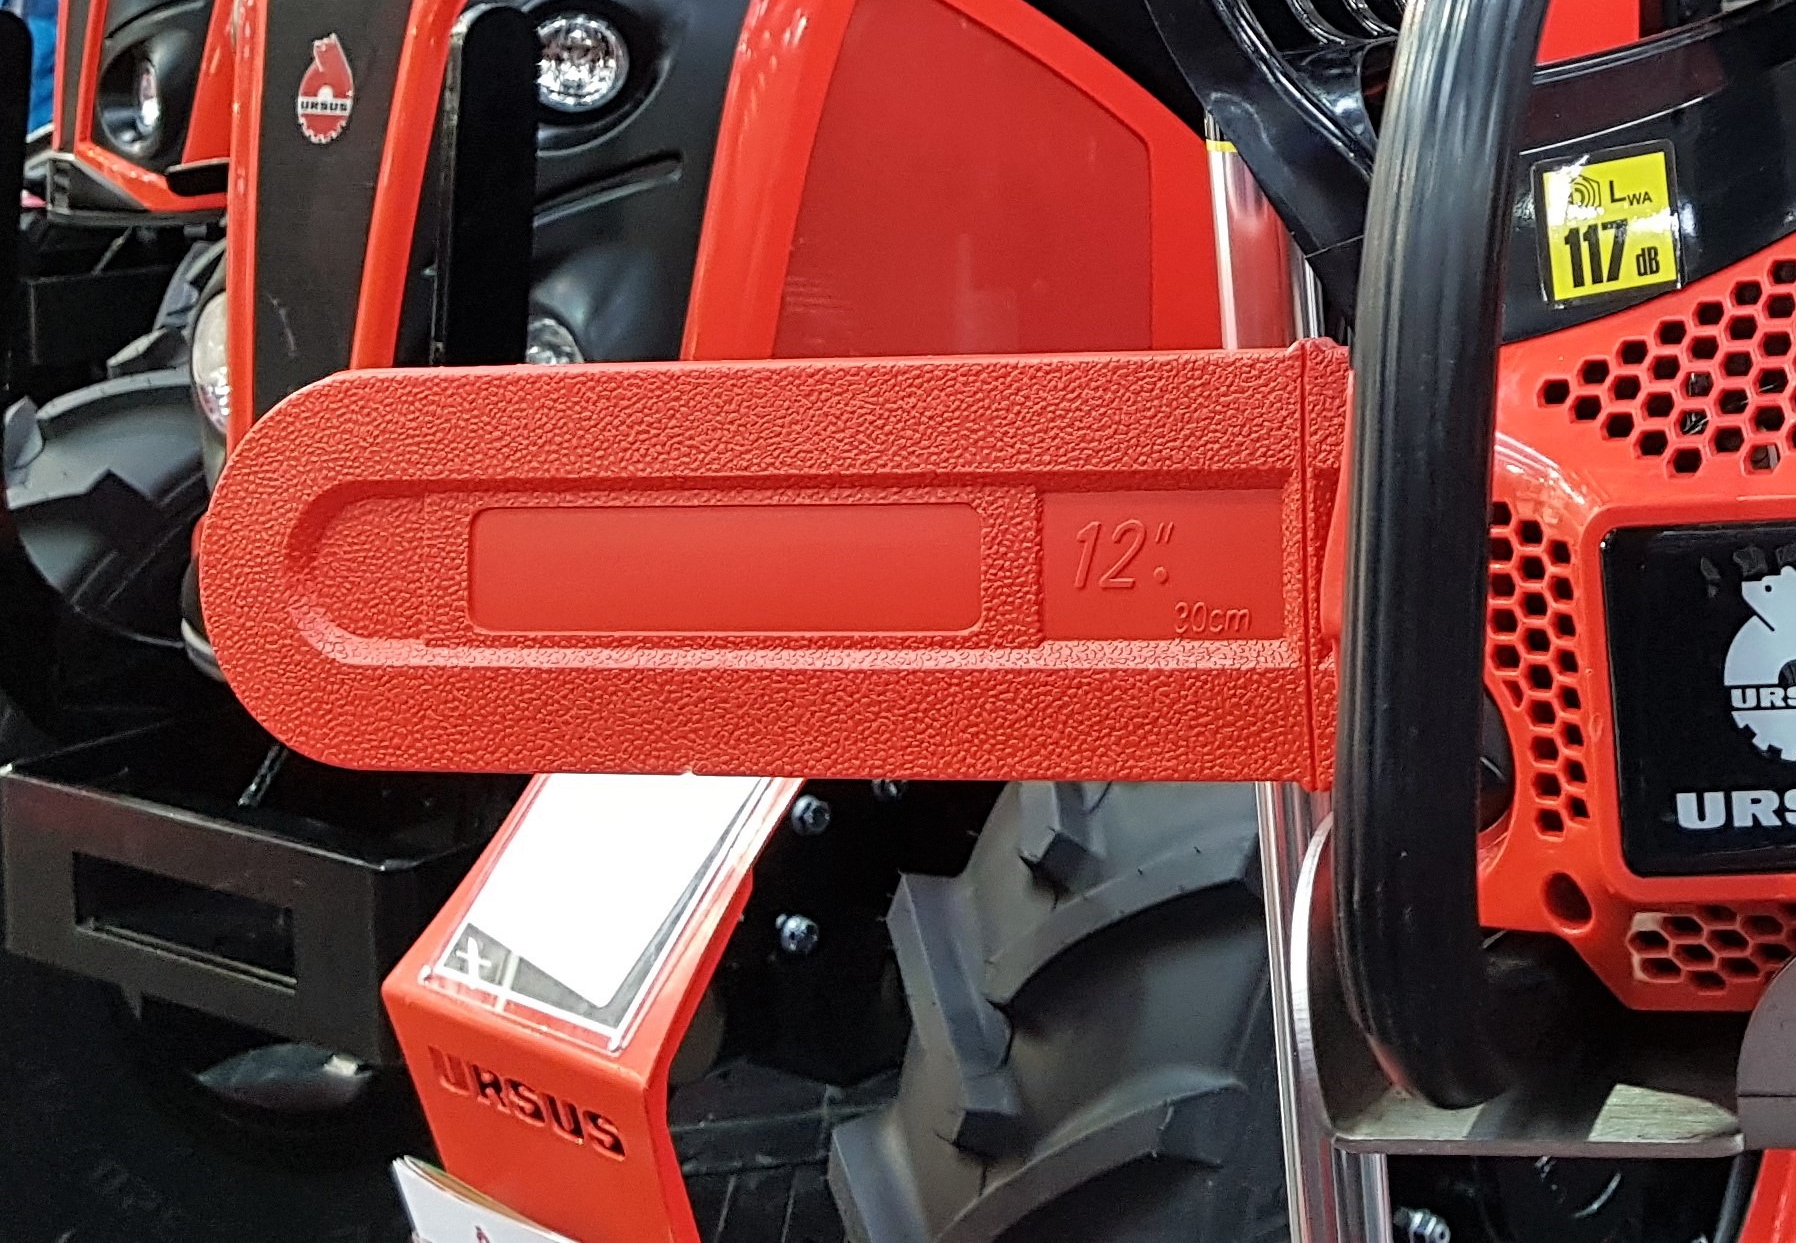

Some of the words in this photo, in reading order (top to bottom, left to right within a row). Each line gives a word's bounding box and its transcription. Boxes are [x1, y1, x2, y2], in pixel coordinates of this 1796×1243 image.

[300, 100, 348, 112] URSUS
[1564, 218, 1629, 289] 117
[1635, 245, 1661, 278] dB
[1173, 600, 1251, 635] 30cm
[428, 1044, 627, 1162] URSUS
